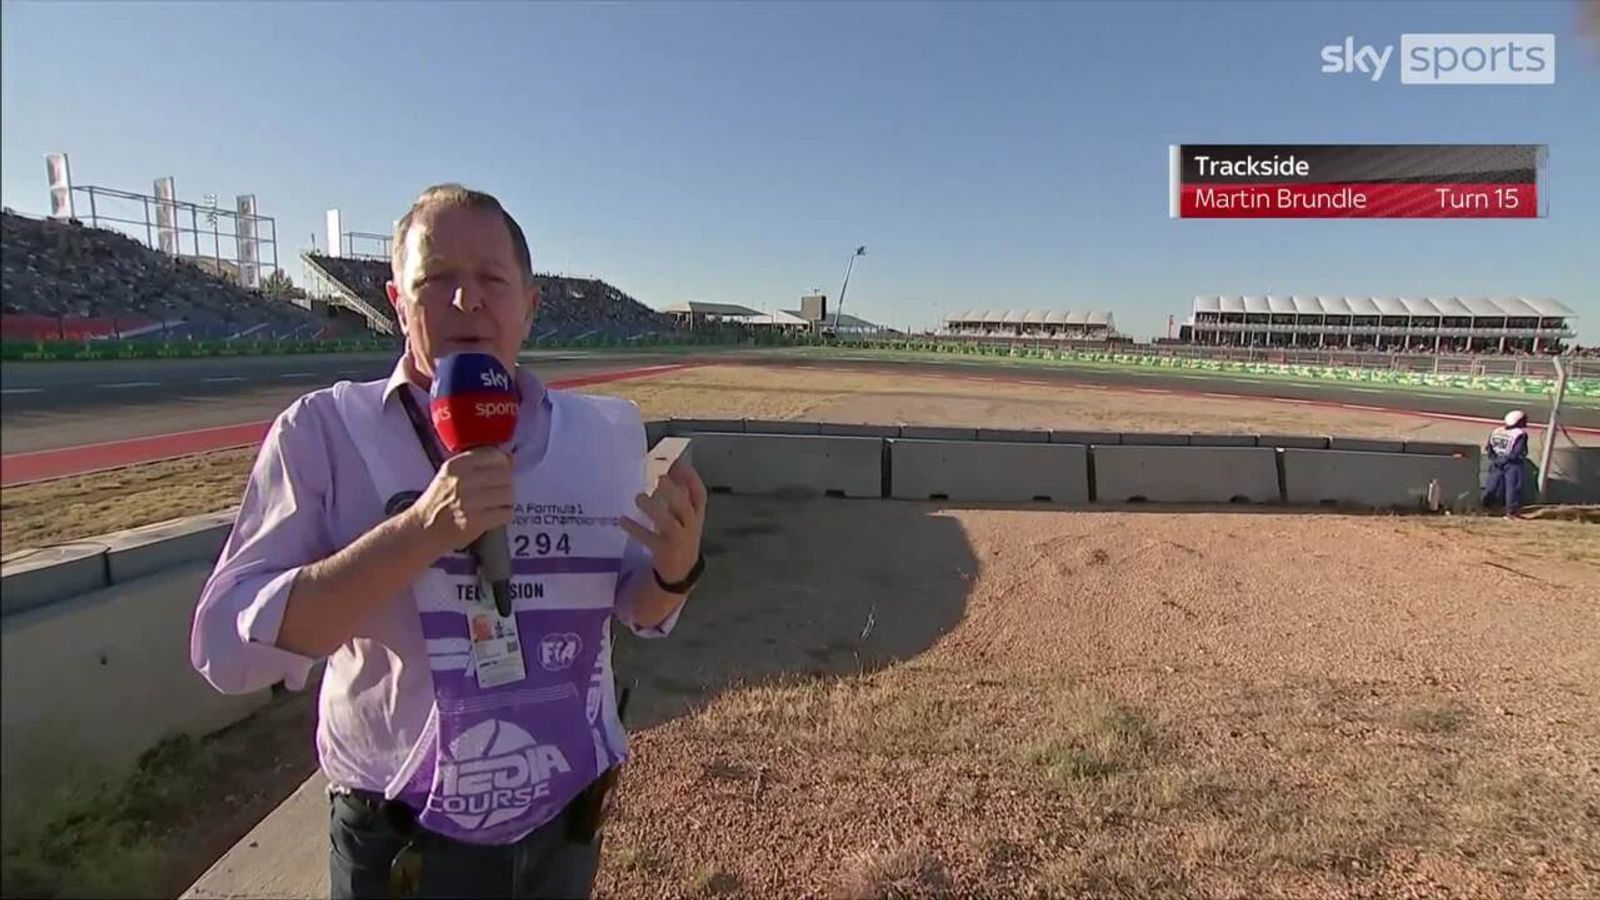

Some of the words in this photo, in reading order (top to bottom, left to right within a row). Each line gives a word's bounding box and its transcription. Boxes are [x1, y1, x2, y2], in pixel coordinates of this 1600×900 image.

[480, 368, 509, 391] sky
[527, 503, 576, 514] Formula
[512, 515, 541, 525] orld
[543, 515, 620, 526] Champion
[514, 532, 571, 557] 294
[456, 583, 544, 601] TELSION
